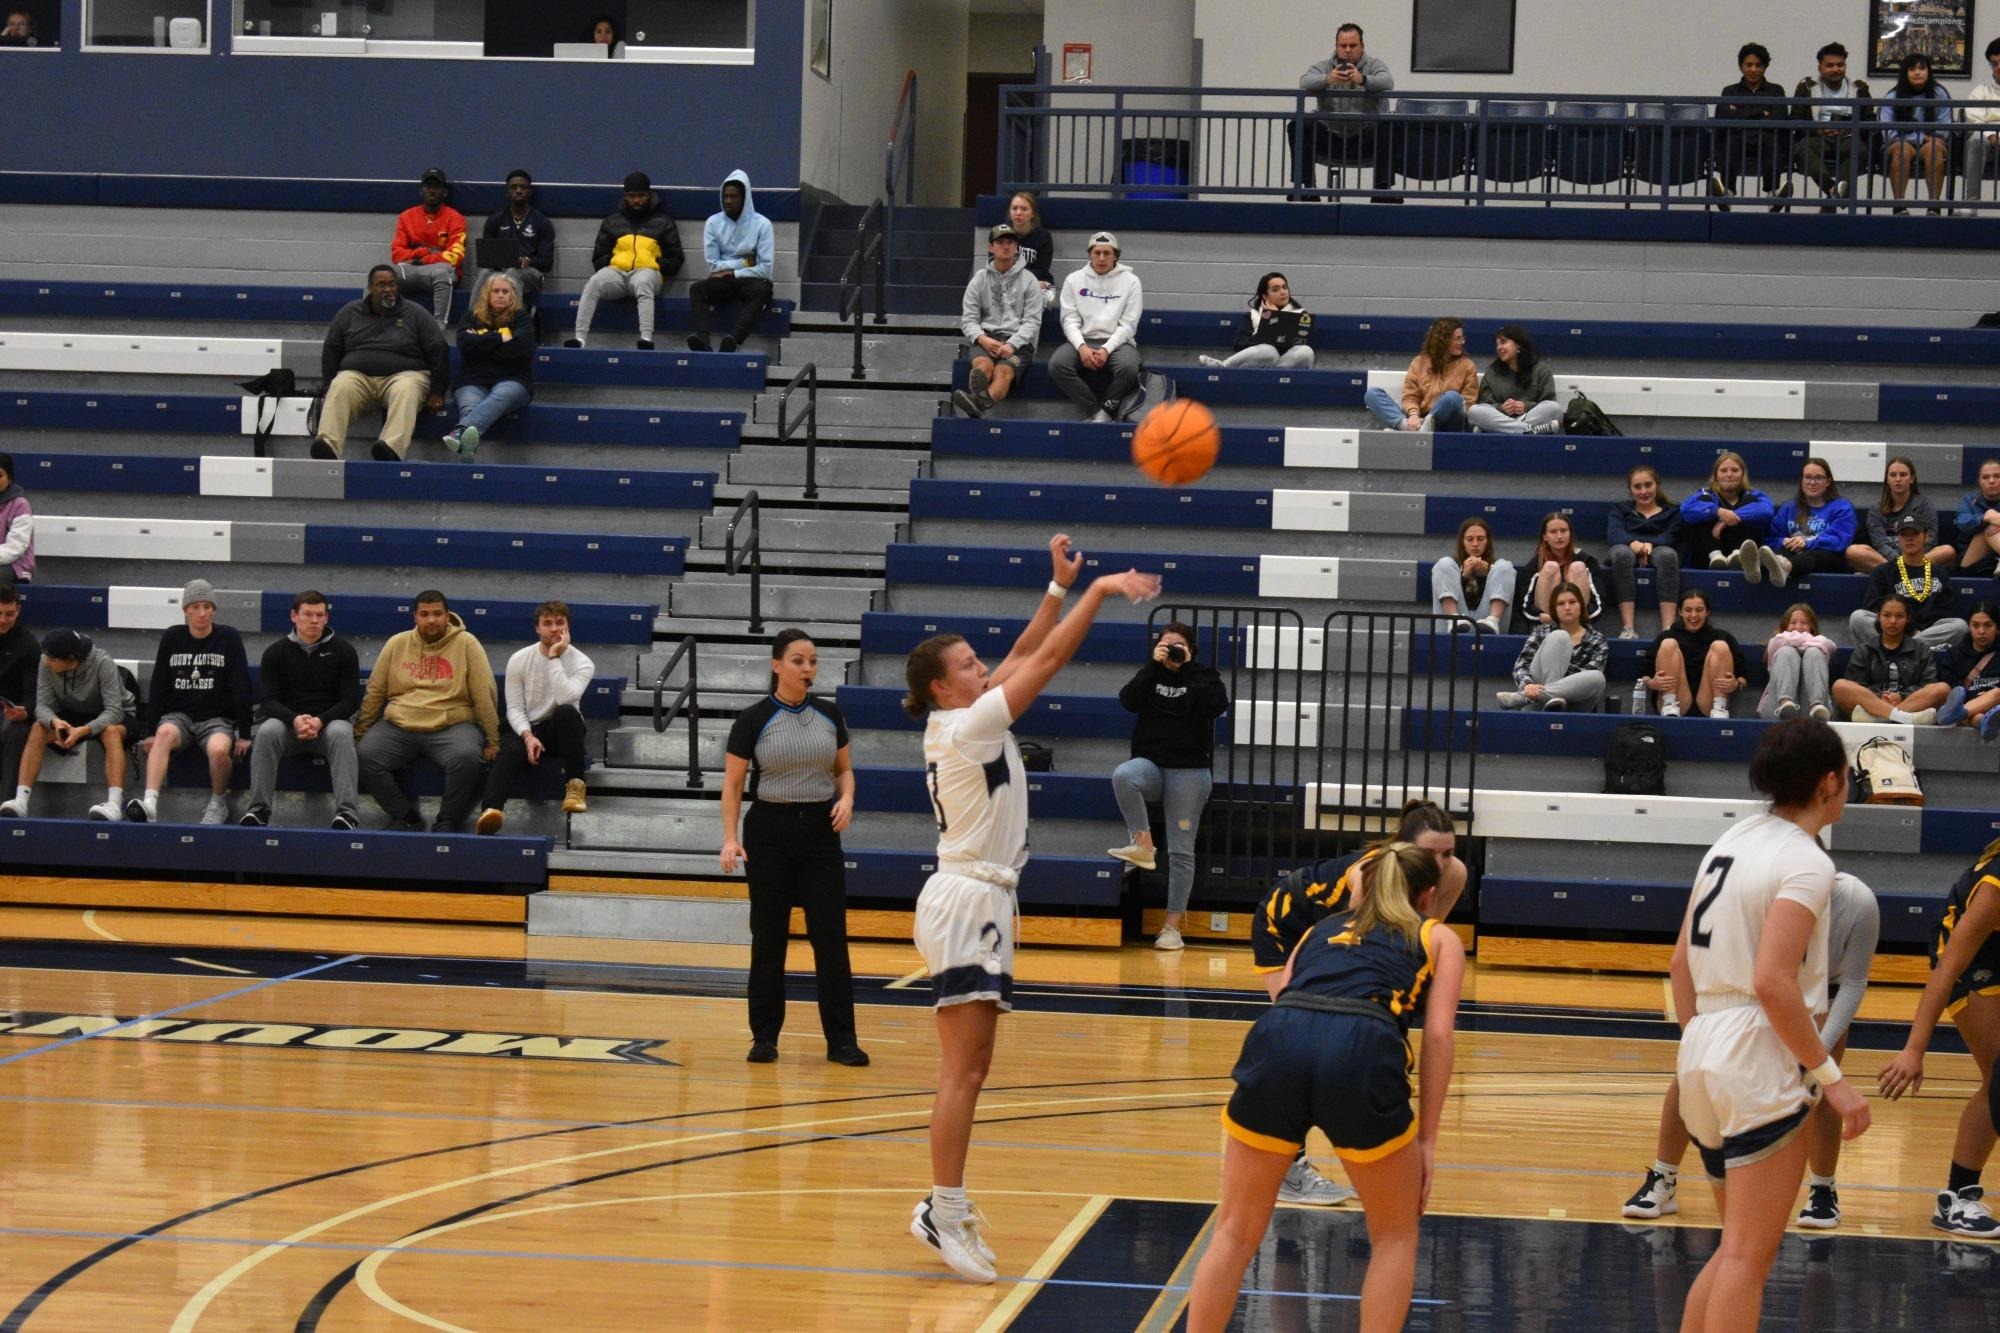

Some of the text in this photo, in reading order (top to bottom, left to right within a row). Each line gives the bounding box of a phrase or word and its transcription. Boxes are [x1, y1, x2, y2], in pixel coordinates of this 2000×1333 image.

[1079, 287, 1122, 304] Champion
[169, 652, 225, 667] MOUNT ALOYSIUS
[421, 655, 437, 665] THE
[174, 677, 214, 690] COLLEGE
[1690, 855, 1735, 948] 2
